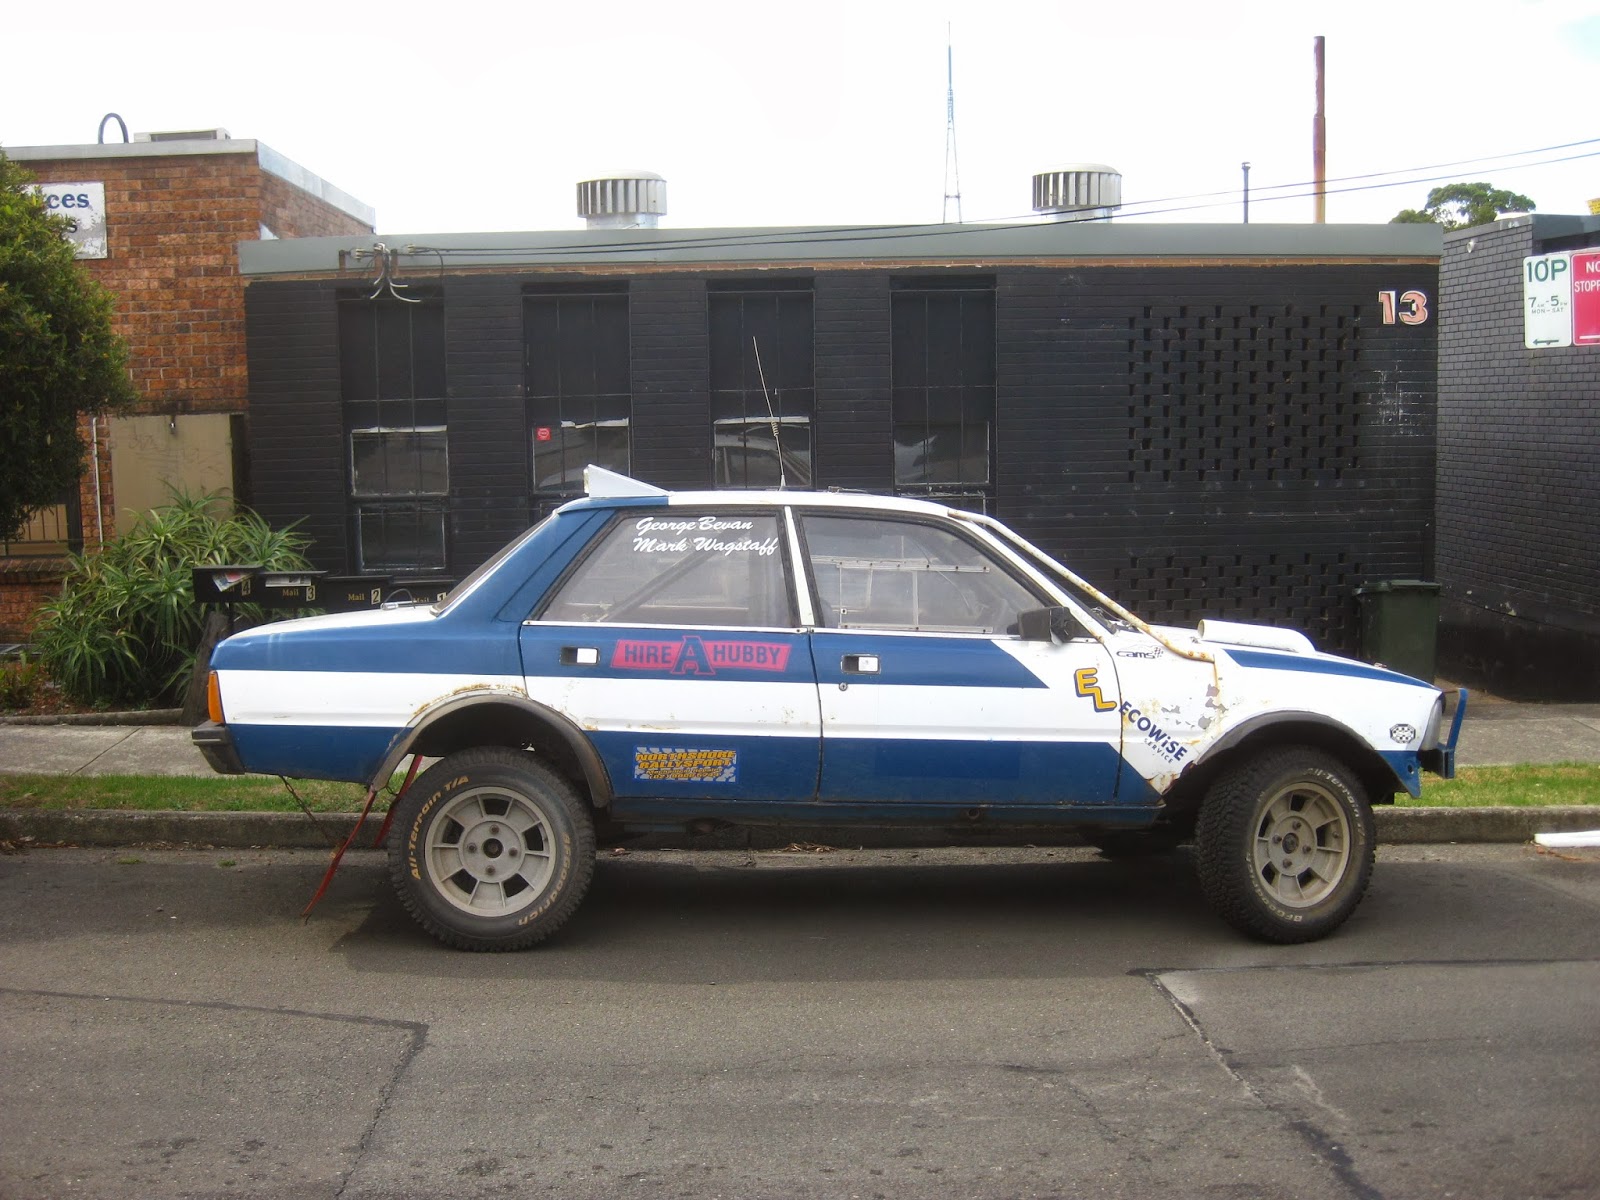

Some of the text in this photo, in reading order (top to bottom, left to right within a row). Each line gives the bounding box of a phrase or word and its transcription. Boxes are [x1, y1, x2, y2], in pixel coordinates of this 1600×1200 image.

[46, 193, 90, 209] ces
[1526, 259, 1567, 282] 10P
[1378, 290, 1428, 325] 13
[635, 516, 753, 536] George Bevan
[632, 537, 779, 556] Mark Wagstaff
[242, 580, 250, 595] 4
[282, 586, 315, 600] Mail 3
[347, 589, 380, 603] Mail 2
[624, 635, 781, 675] HIRE A HUBBY
[636, 750, 736, 761] NORTHSHORE
[1144, 738, 1174, 763] SERVICE
[639, 759, 731, 769] RALLYSPORT
[408, 775, 469, 880] All-Terrain T/A
